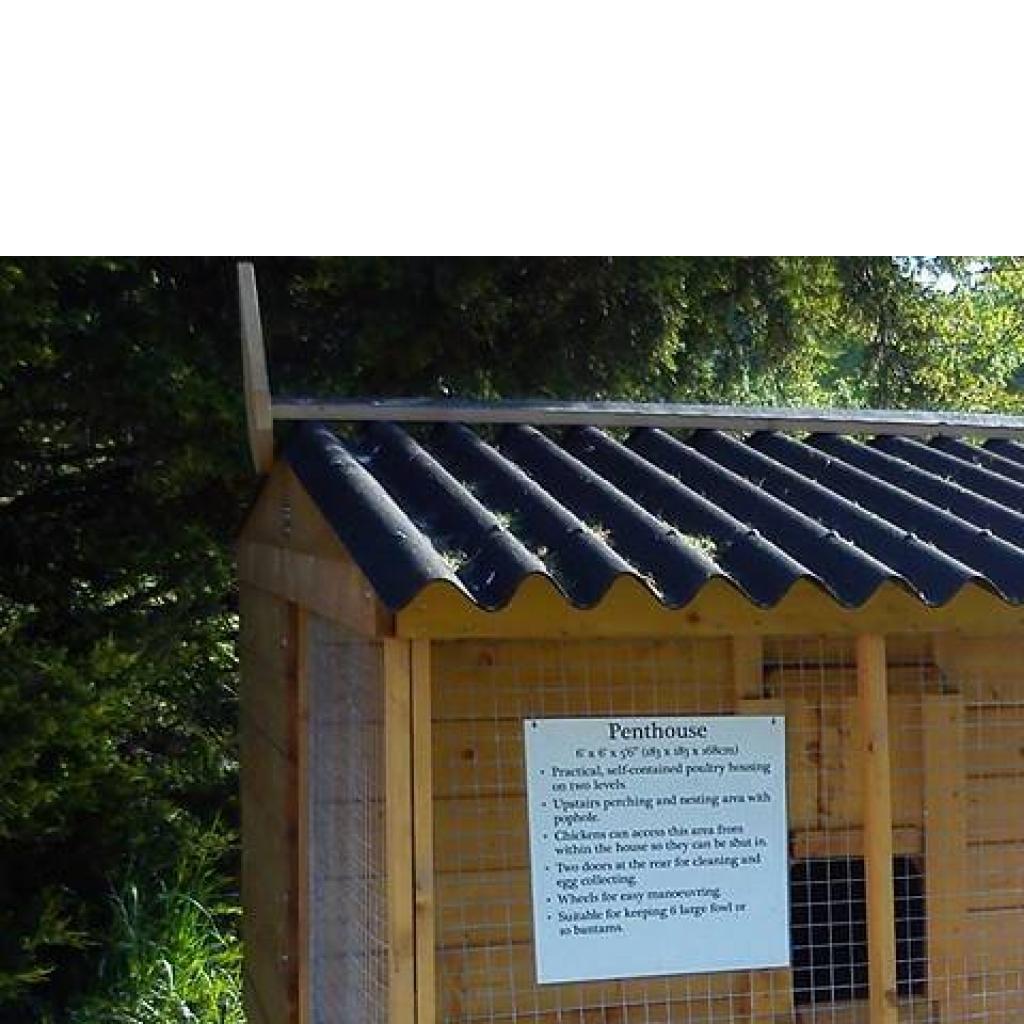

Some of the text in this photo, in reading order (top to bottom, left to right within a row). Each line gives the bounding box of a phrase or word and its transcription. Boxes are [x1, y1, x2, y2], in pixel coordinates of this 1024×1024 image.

[608, 721, 707, 739] Penthouse
[552, 761, 771, 778] Practical, self-contained poultry housing
[552, 782, 566, 791] on
[569, 781, 590, 791] two
[553, 791, 771, 812] Upstairs perching and nesting area with
[554, 824, 743, 840] Chickens can access this area from
[554, 844, 591, 854] within
[595, 843, 612, 853] the
[616, 842, 648, 852] house
[666, 840, 688, 854] they
[692, 841, 710, 850] can
[714, 838, 726, 848] be
[729, 837, 751, 848] shut
[557, 854, 762, 873] Two doors at the rear for cleaning and
[557, 877, 578, 890] egg
[557, 891, 599, 903] Wheels
[601, 891, 619, 901] for
[621, 891, 644, 904] easy
[559, 902, 747, 921] Suitable for keeping 6 large fowl or
[560, 927, 572, 936] 10
